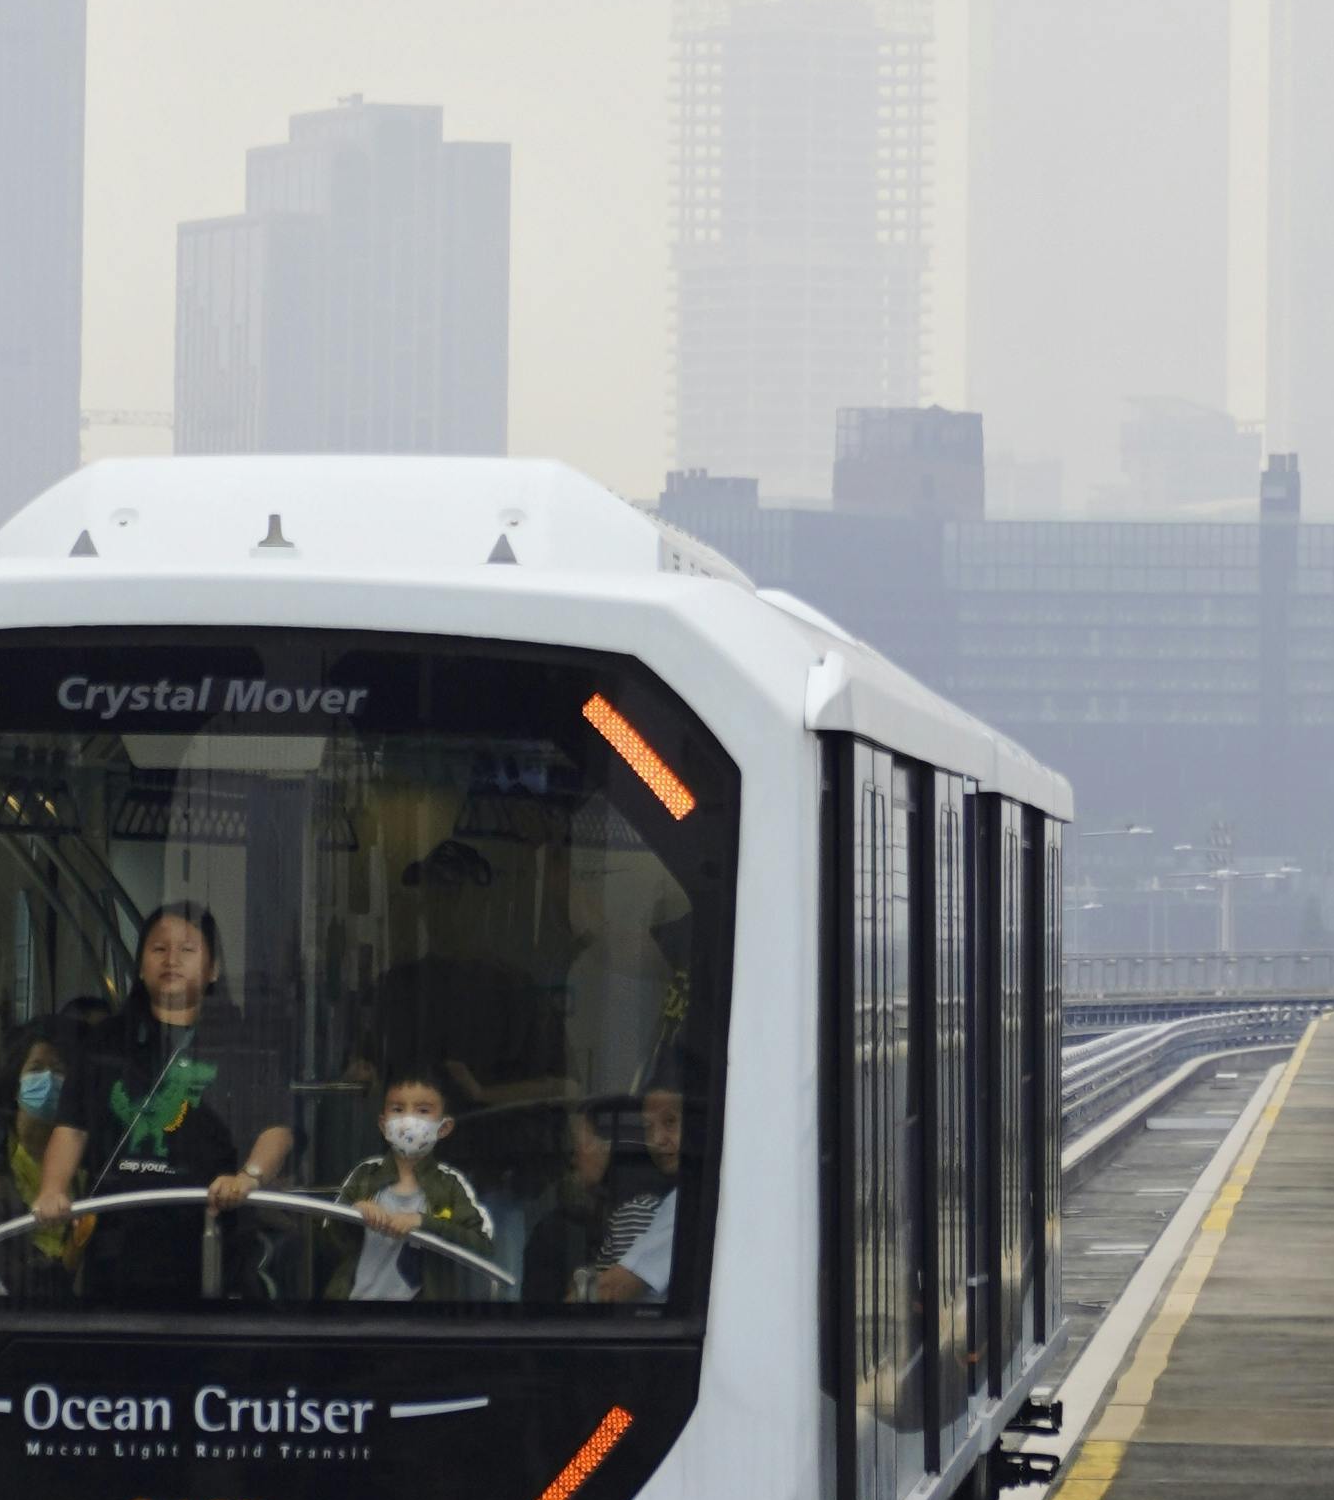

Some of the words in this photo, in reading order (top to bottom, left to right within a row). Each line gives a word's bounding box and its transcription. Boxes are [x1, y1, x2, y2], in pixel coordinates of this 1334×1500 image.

[57, 677, 213, 719] Crystal
[224, 680, 368, 714] Mover
[23, 1383, 172, 1432] Ocean
[194, 1384, 374, 1434] Cruiser
[25, 1442, 97, 1457] Macau
[113, 1442, 179, 1460] Light
[195, 1443, 263, 1461] Rapid
[278, 1444, 371, 1461] Transit
